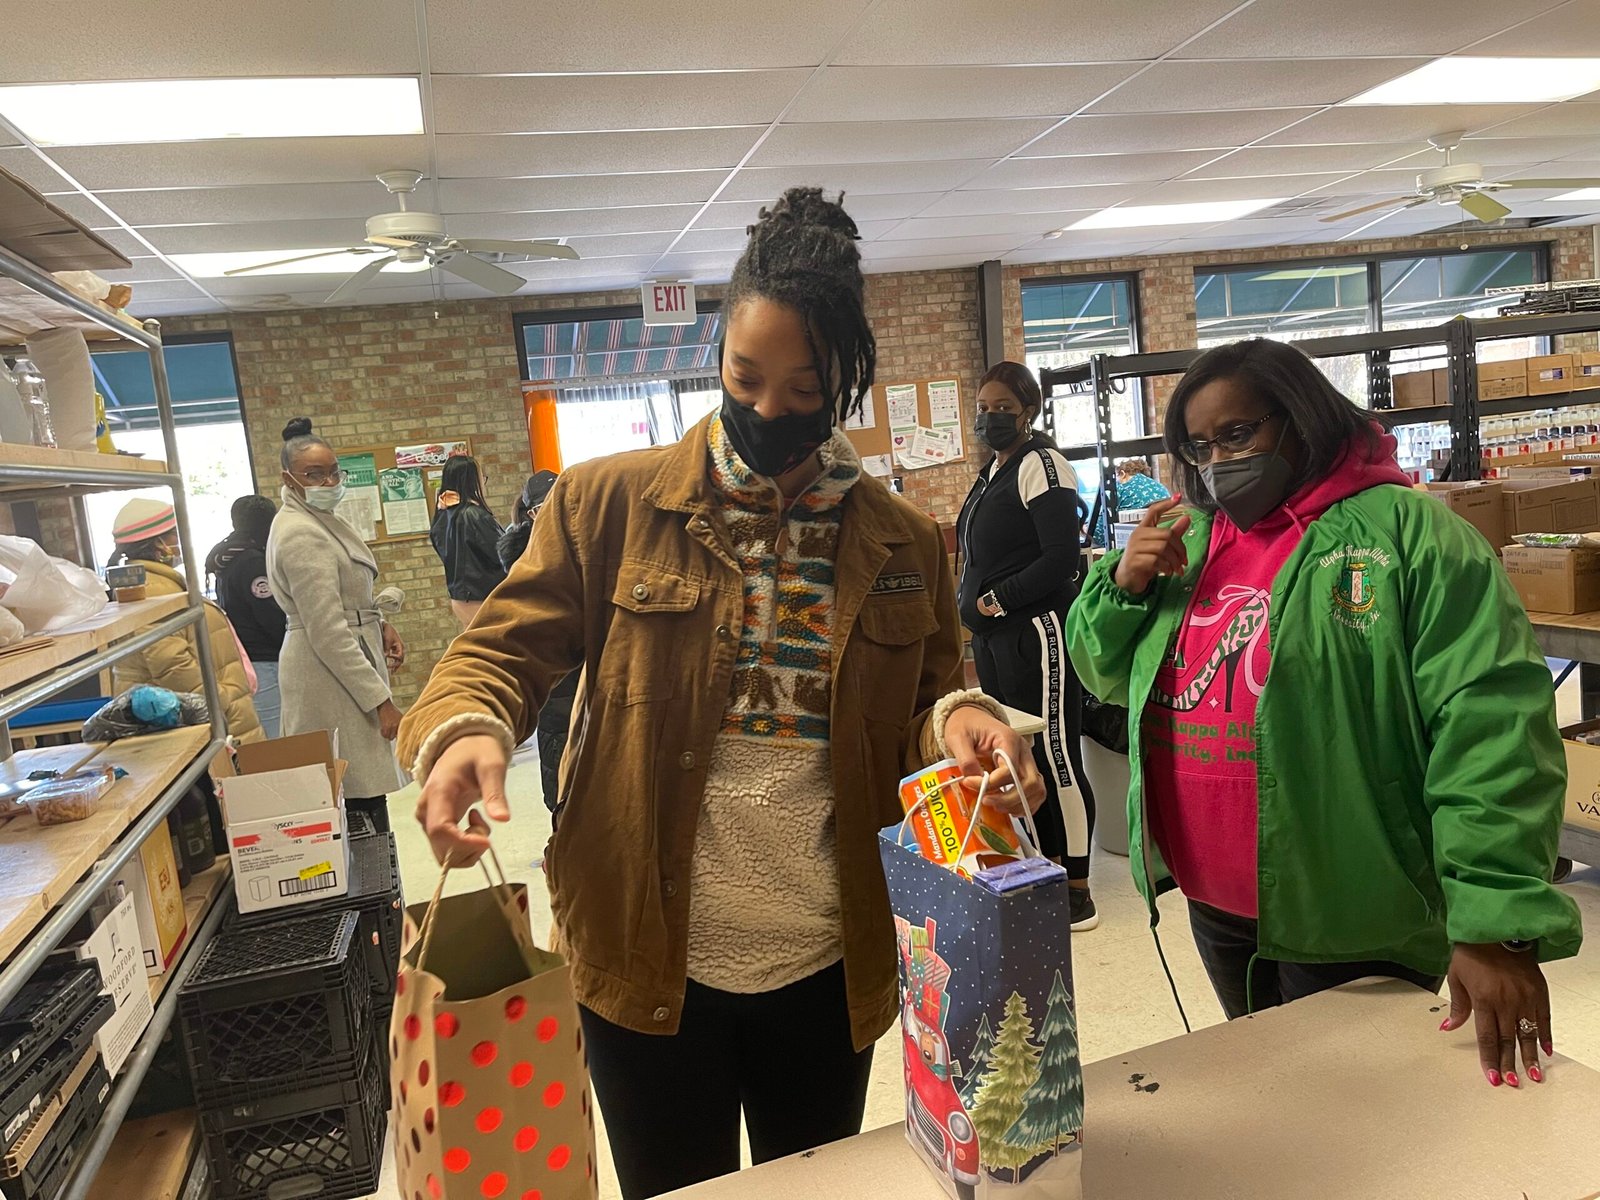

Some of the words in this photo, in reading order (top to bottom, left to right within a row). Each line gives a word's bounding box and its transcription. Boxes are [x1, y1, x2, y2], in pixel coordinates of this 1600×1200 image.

[653, 286, 687, 312] EXIT
[1044, 458, 1057, 480] RLGN
[1320, 550, 1345, 568] Alpha
[1369, 547, 1391, 568] Alpha
[1041, 612, 1055, 634] TRUE
[1049, 636, 1058, 663] RLGN
[1051, 666, 1059, 690] TRUE
[1050, 692, 1059, 715] RLGN
[1050, 718, 1059, 741] TRUE
[1169, 717, 1219, 740] Kappa
[1052, 741, 1064, 765] RLGN
[923, 818, 943, 859] Mandarin
[113, 962, 137, 998] ESERVE
